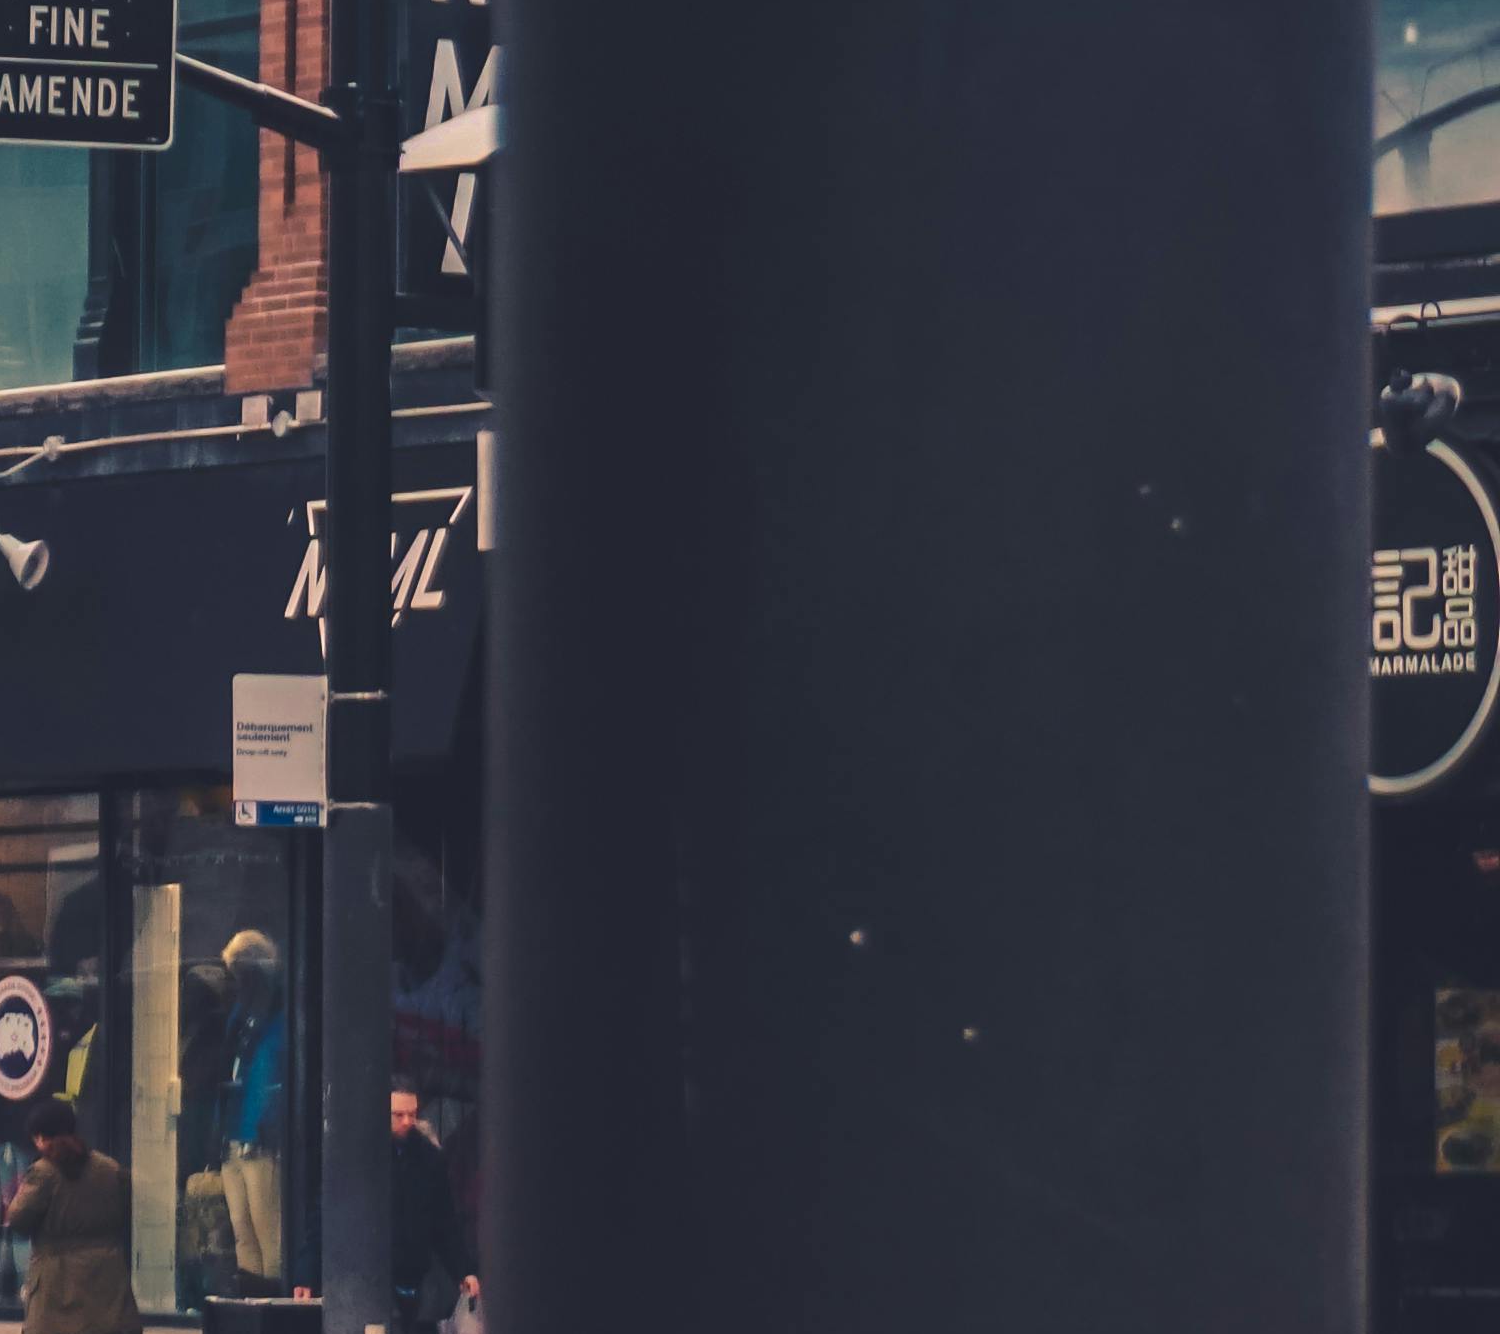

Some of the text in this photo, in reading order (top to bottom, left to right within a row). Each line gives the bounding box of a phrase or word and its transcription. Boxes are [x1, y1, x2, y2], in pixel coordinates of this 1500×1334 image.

[29, 5, 110, 49] FINE
[284, 527, 447, 619] NML
[1369, 650, 1477, 677] MARMALADE
